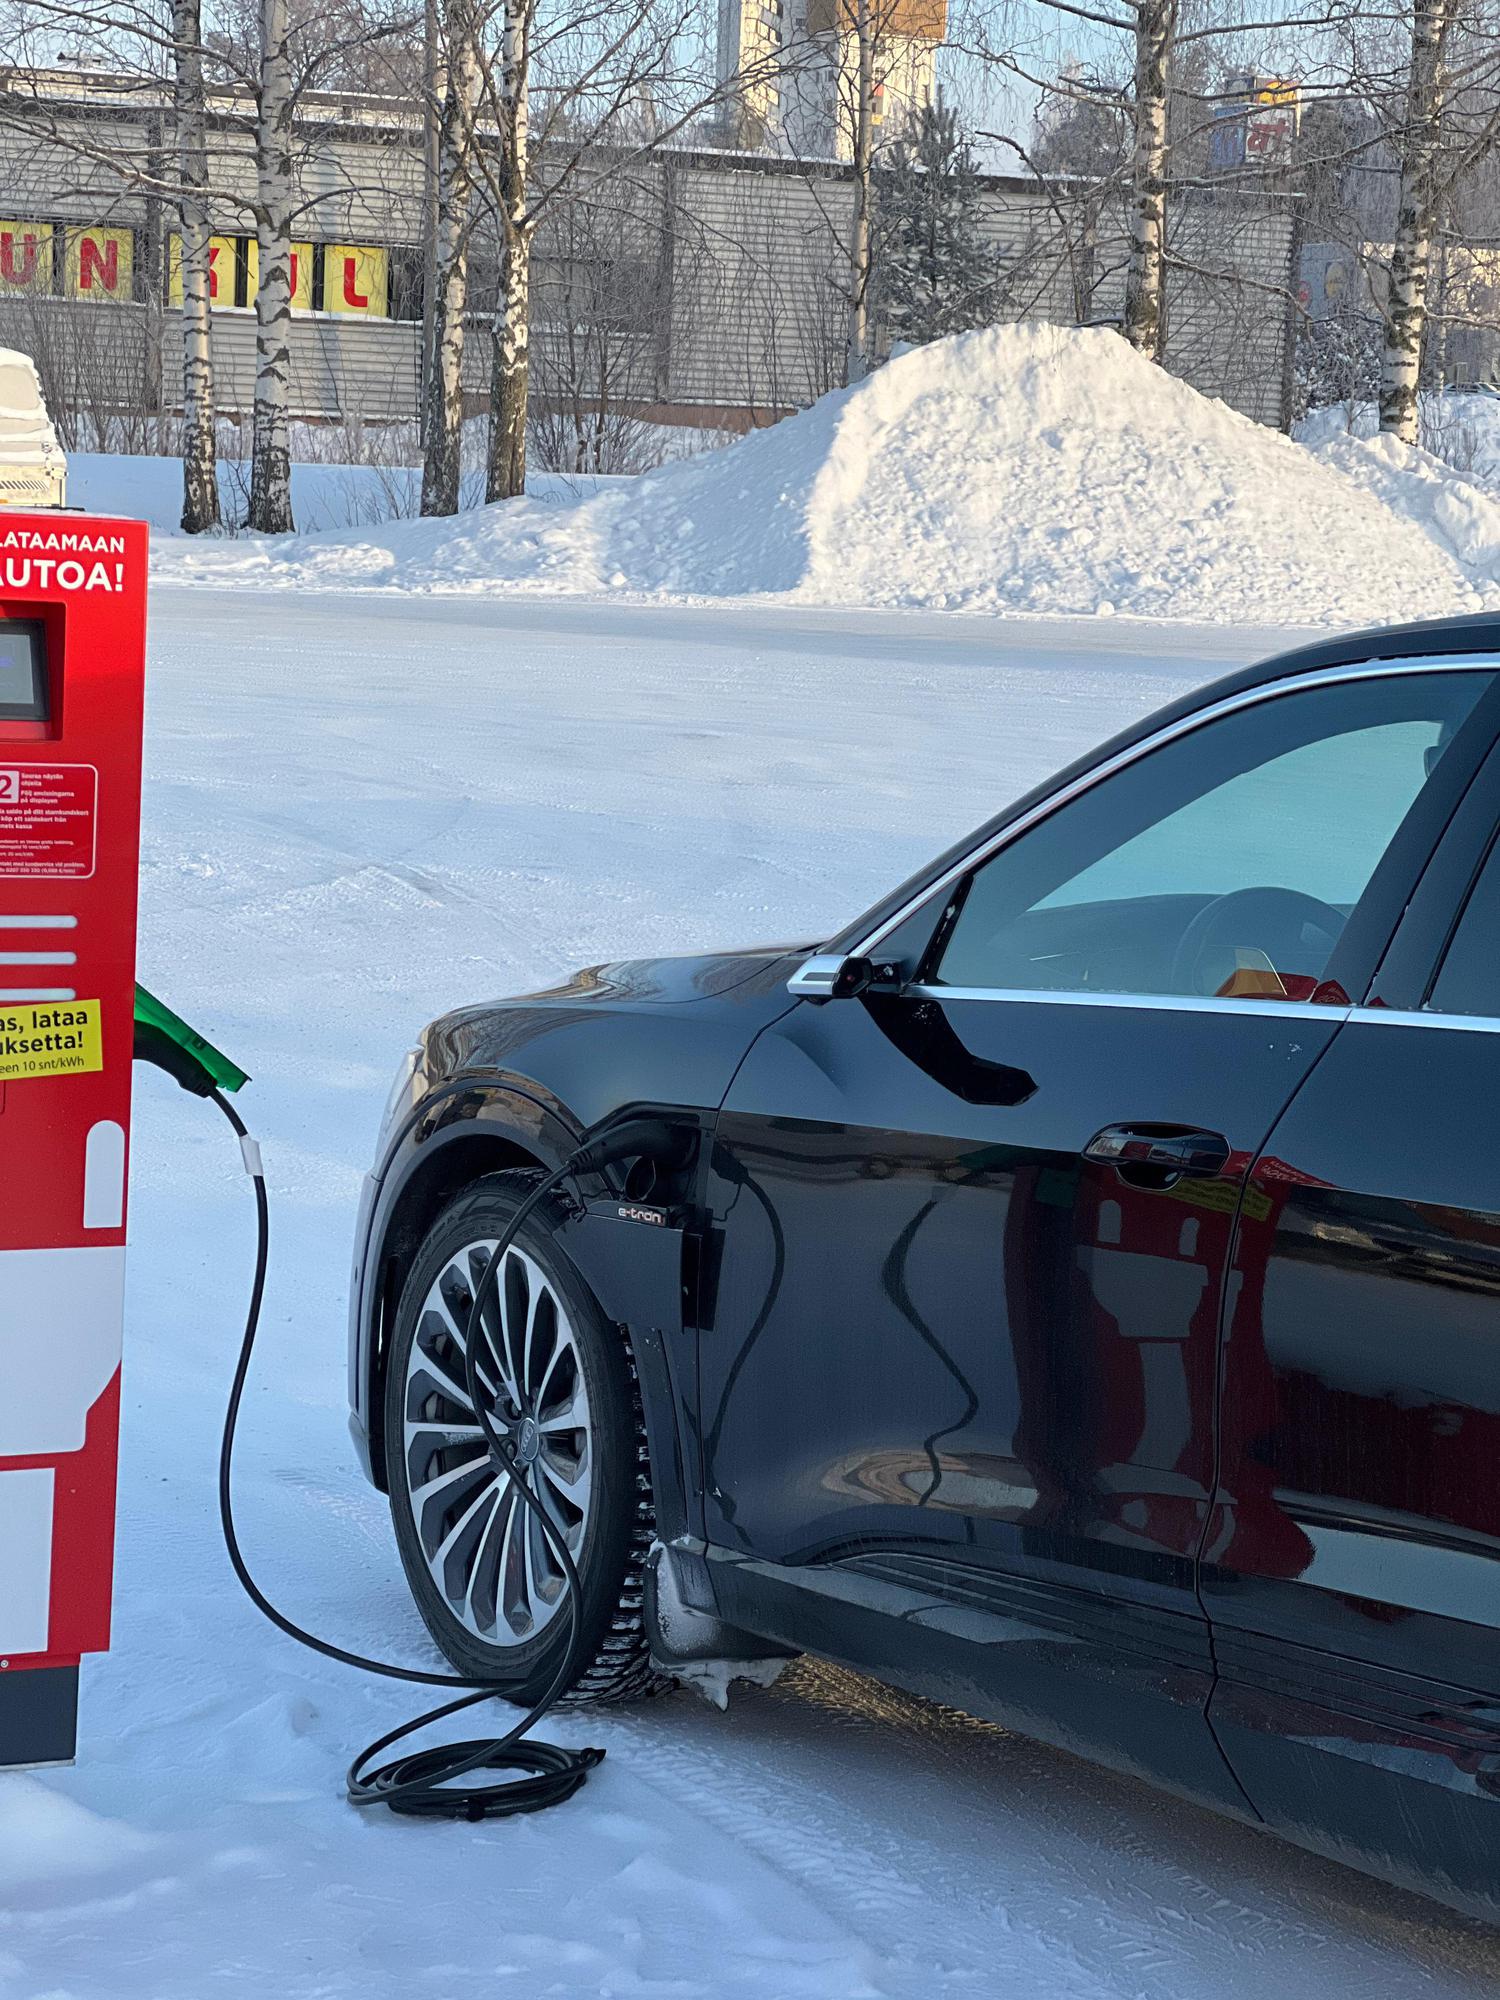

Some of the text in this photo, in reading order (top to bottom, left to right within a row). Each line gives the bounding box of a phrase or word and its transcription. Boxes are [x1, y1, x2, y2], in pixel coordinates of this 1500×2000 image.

[0, 558, 123, 591] UTOA!
[0, 775, 12, 799] 2
[32, 1011, 88, 1029] lataa
[0, 1031, 83, 1055] ksetta!
[23, 1060, 36, 1072] 10
[38, 1056, 84, 1071] snt/kWh
[618, 1207, 662, 1223] e-tron
